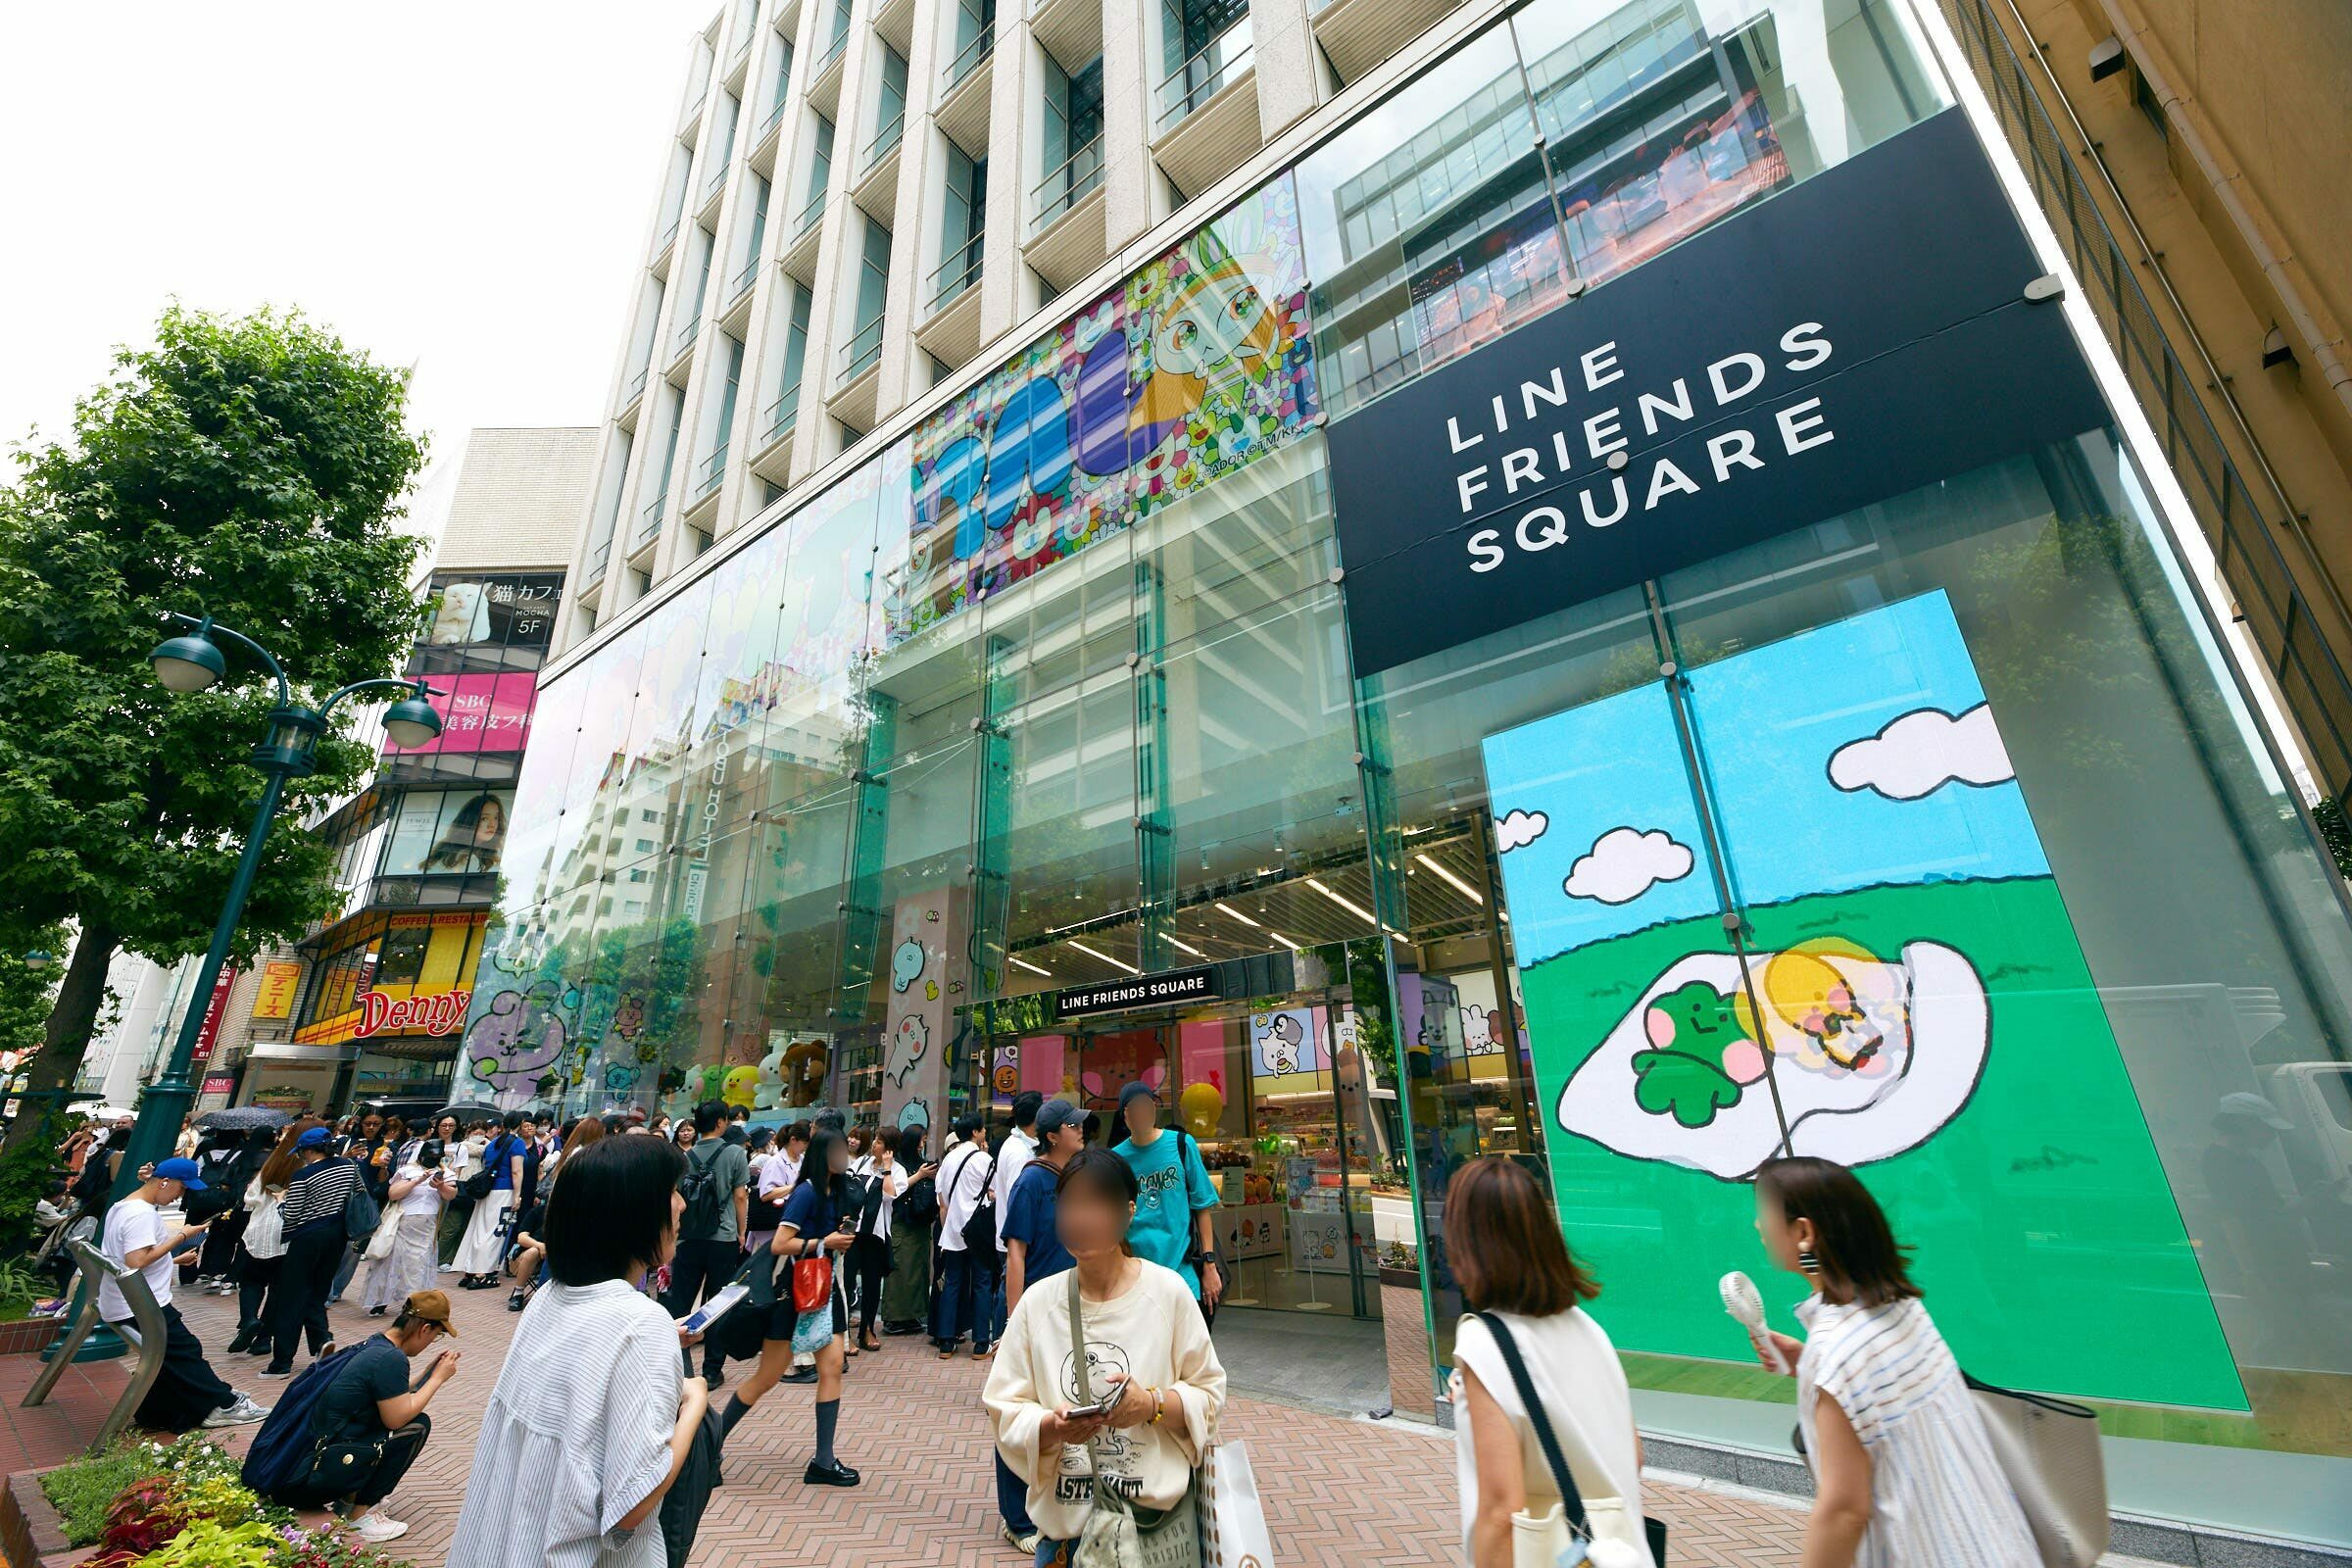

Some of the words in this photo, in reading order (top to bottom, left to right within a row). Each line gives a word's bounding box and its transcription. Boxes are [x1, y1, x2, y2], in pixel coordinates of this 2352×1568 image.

[1446, 340, 1625, 454] LINE
[1456, 321, 1833, 513] FRIENDS
[1467, 396, 1835, 573] SQUARE
[517, 619, 541, 634] 5F
[454, 694, 492, 709] SBC
[391, 915, 429, 926] COFFEE
[263, 976, 293, 1016] デニーズ
[1061, 995, 1090, 1009] LINE
[1093, 986, 1146, 1005] FRIENDS
[1150, 976, 1204, 997] SQUARE
[207, 1078, 231, 1087] SBC
[1056, 1474, 1144, 1499] ASTRAUT
